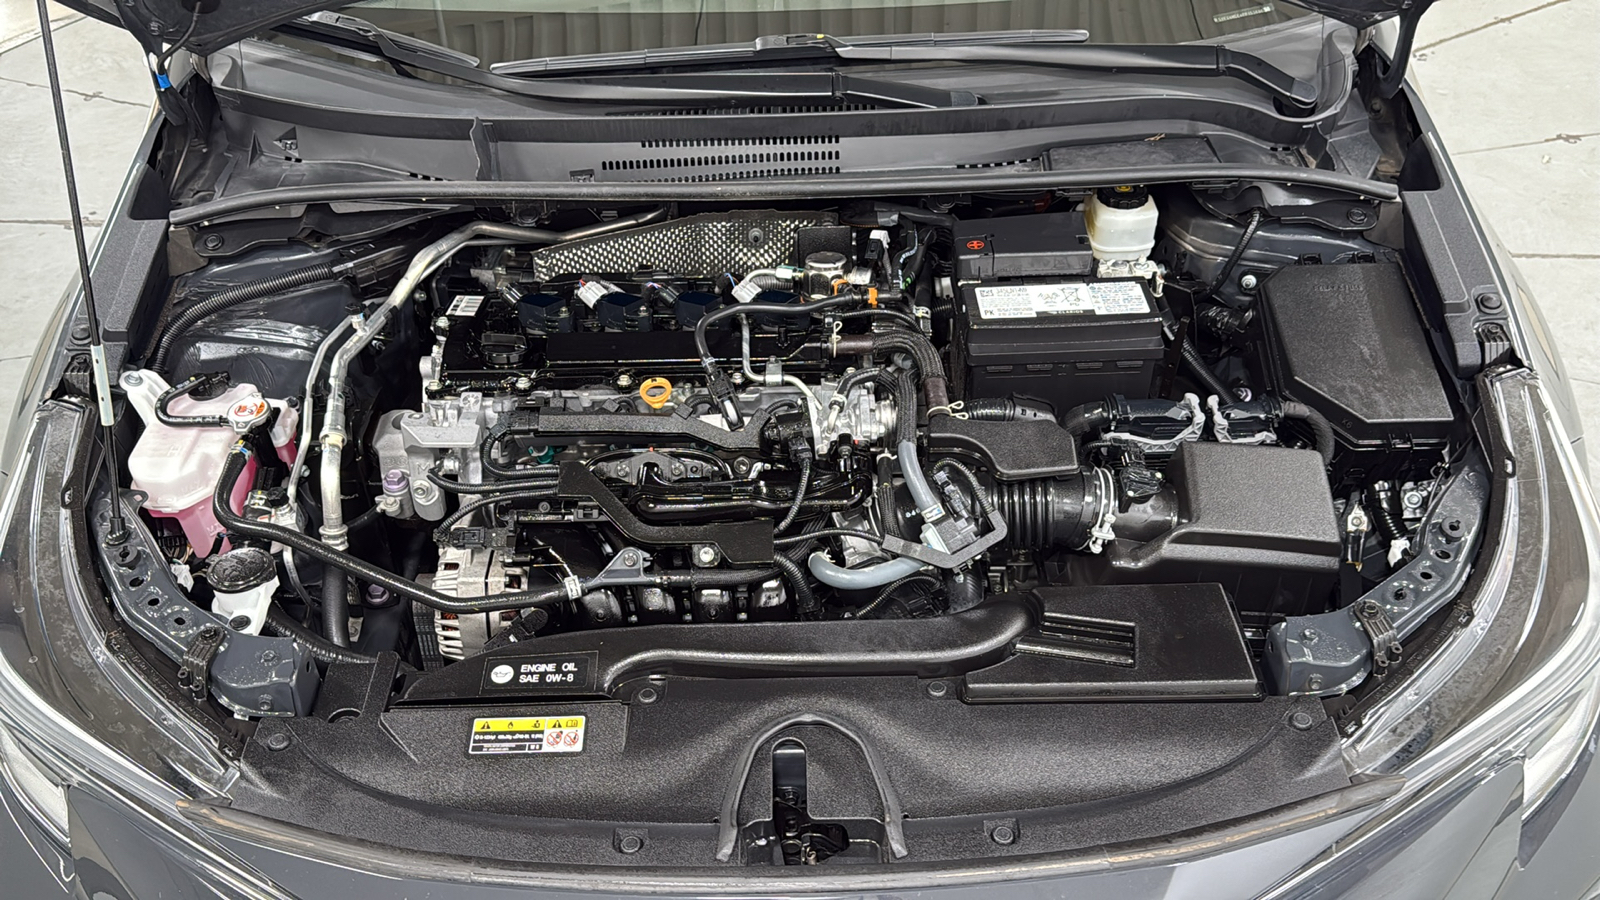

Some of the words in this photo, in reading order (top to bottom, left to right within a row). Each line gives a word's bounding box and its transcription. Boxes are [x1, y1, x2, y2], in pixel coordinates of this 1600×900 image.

[520, 663, 557, 673] ENGINE
[561, 662, 578, 672] OIL
[518, 674, 540, 683] SAE
[545, 673, 574, 683] 0W-8
